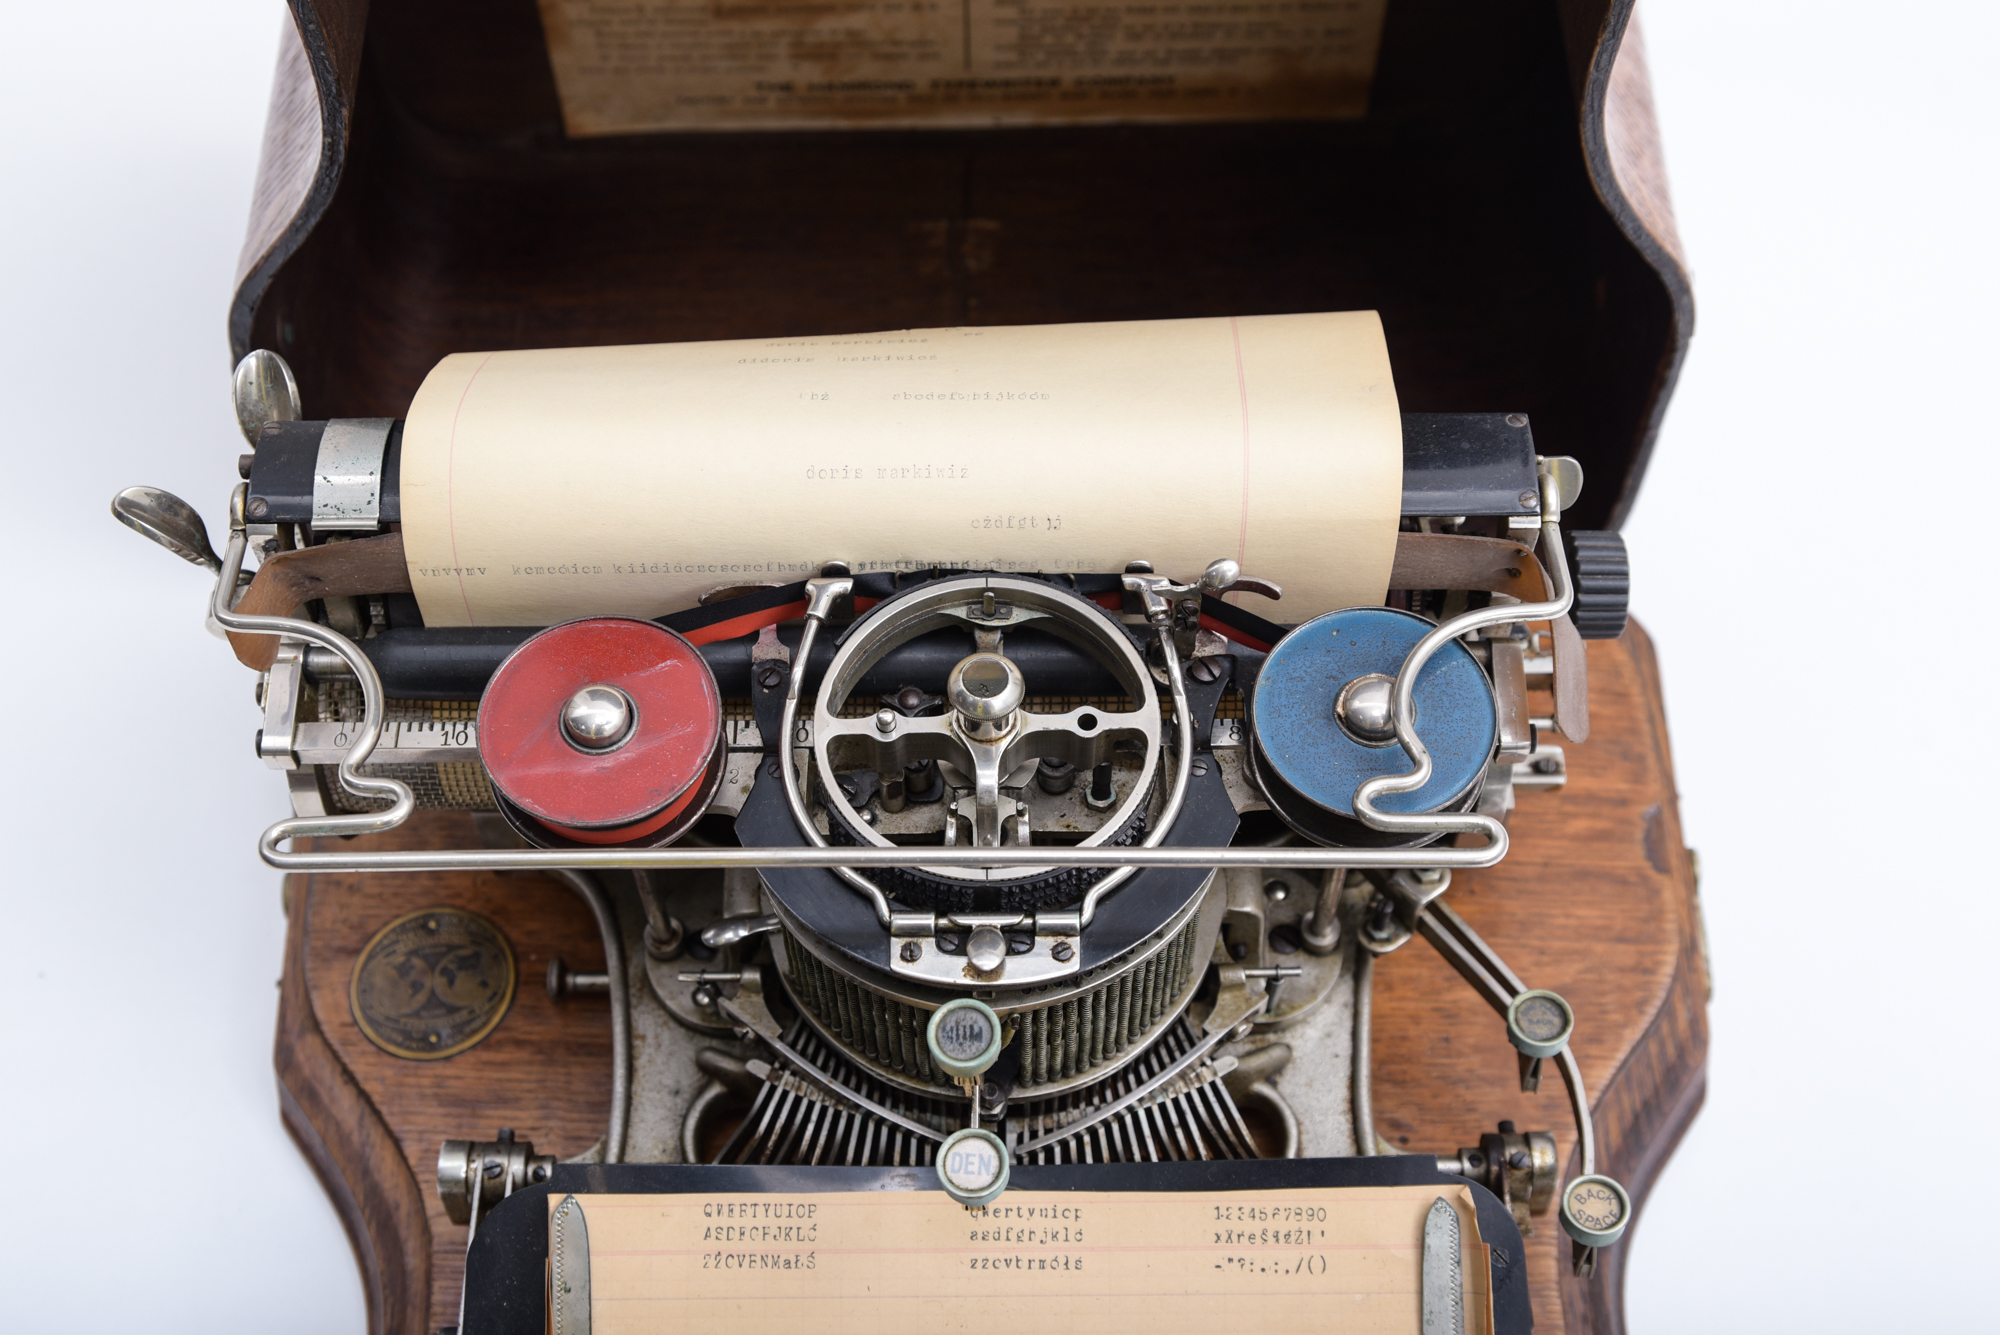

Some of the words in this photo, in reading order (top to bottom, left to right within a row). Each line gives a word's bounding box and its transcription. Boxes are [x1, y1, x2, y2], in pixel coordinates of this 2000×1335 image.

[441, 731, 469, 746] 10
[728, 768, 740, 785] 2
[1574, 1189, 1617, 1206] BACK
